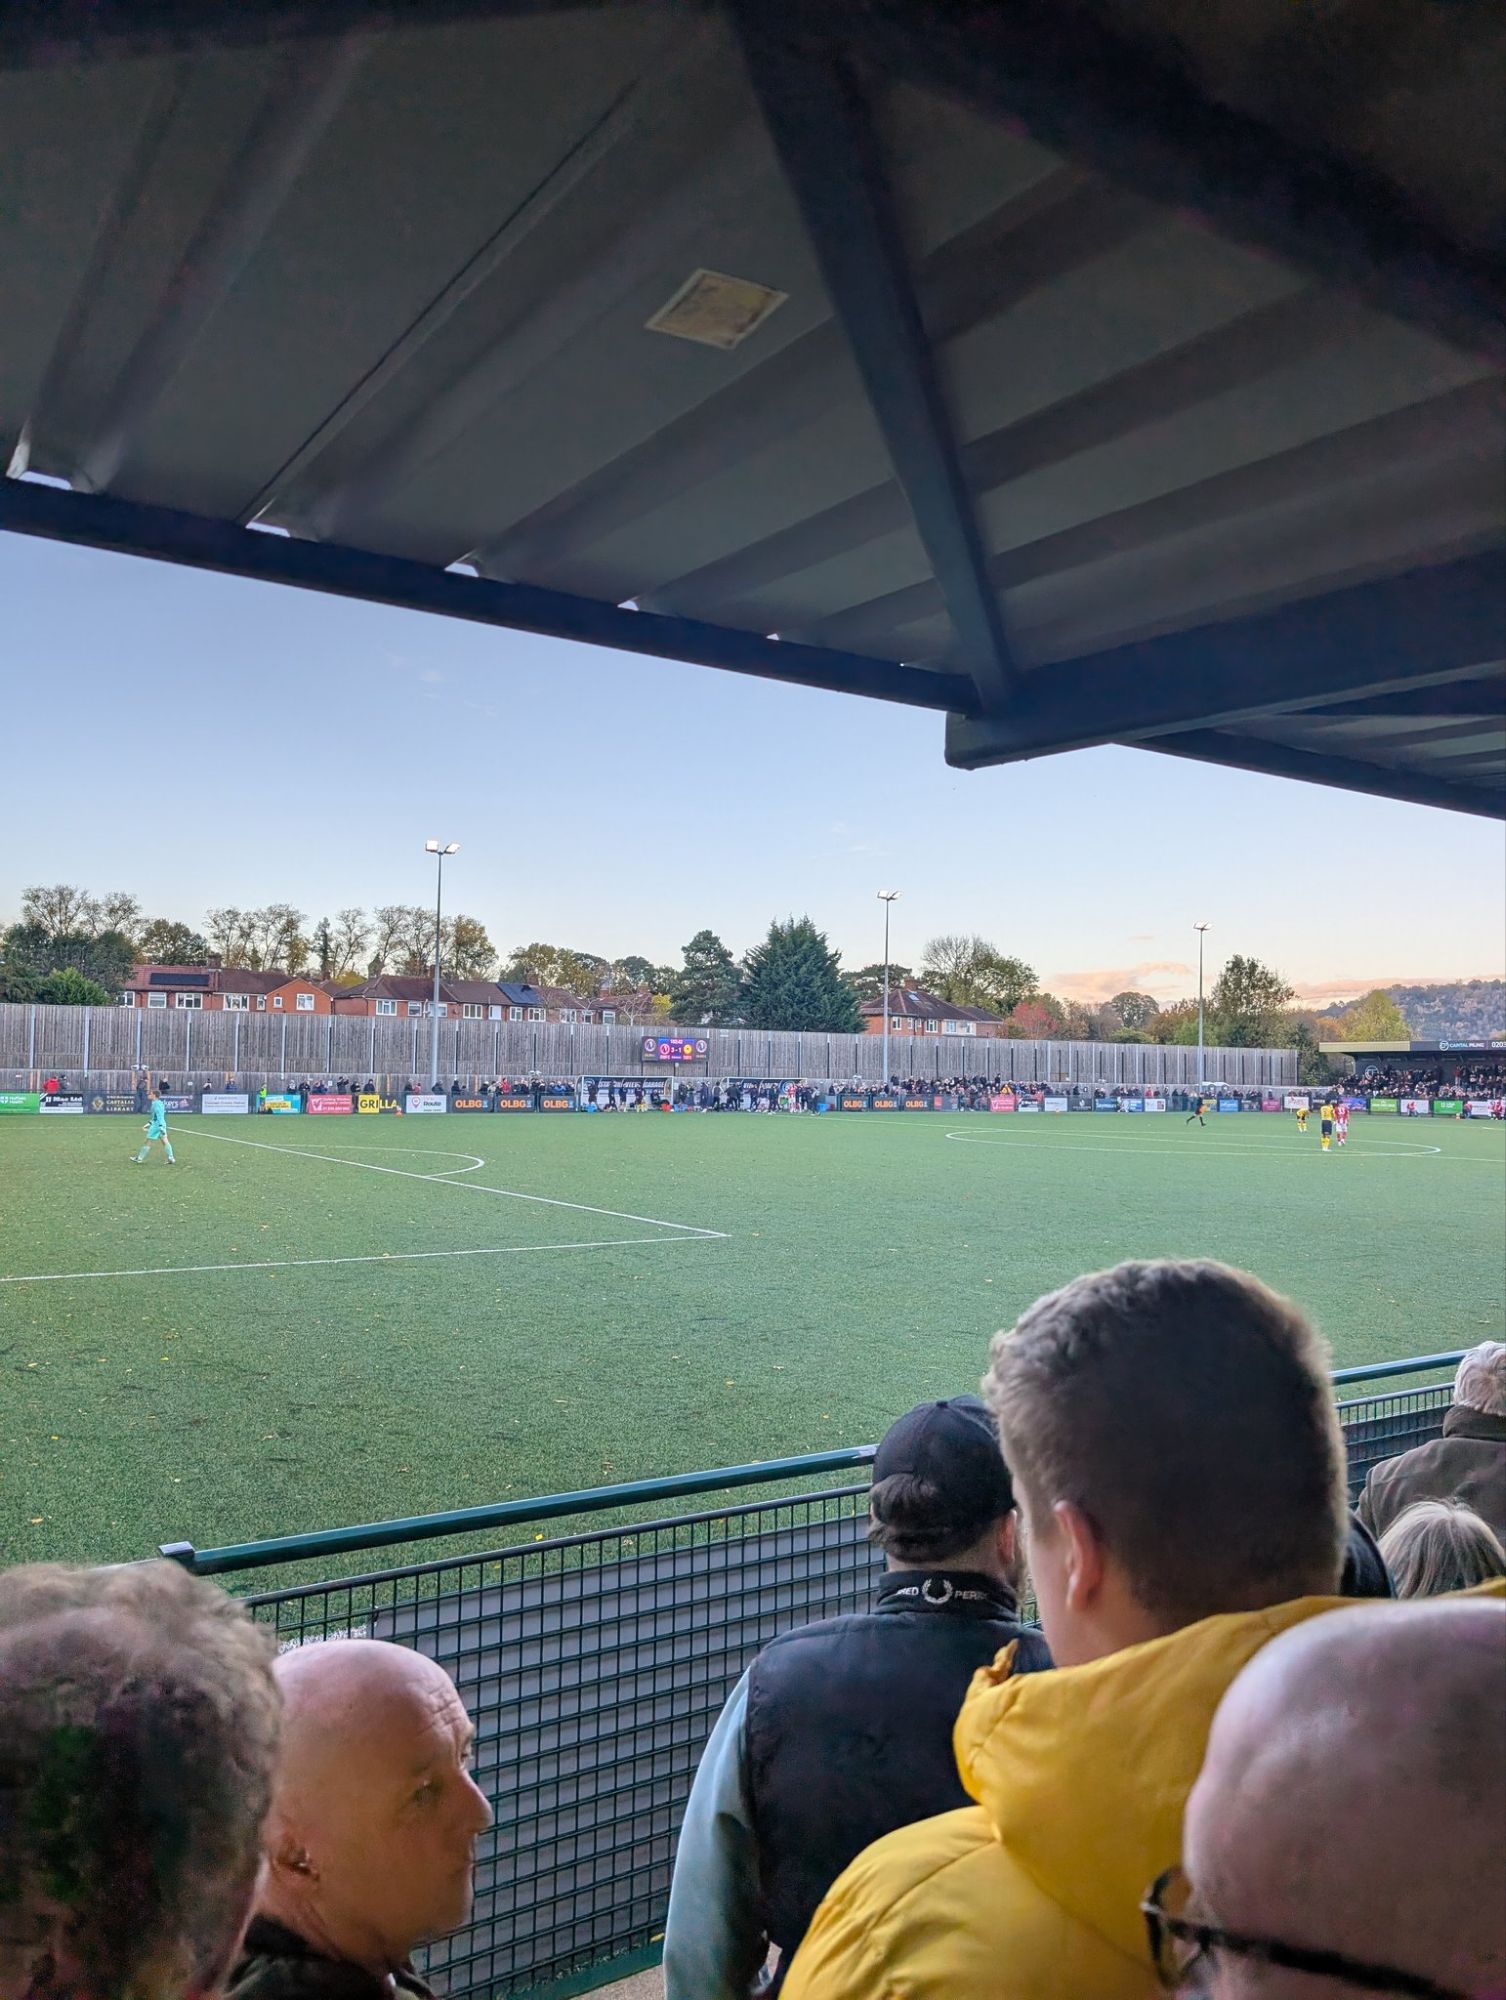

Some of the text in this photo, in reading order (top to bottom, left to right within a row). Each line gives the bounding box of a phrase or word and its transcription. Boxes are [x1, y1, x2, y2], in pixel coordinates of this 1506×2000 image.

[360, 1099, 397, 1109] GRILLA
[455, 1099, 483, 1108] OLBG
[500, 1099, 527, 1108] OLBG
[543, 1100, 569, 1108] OLBG
